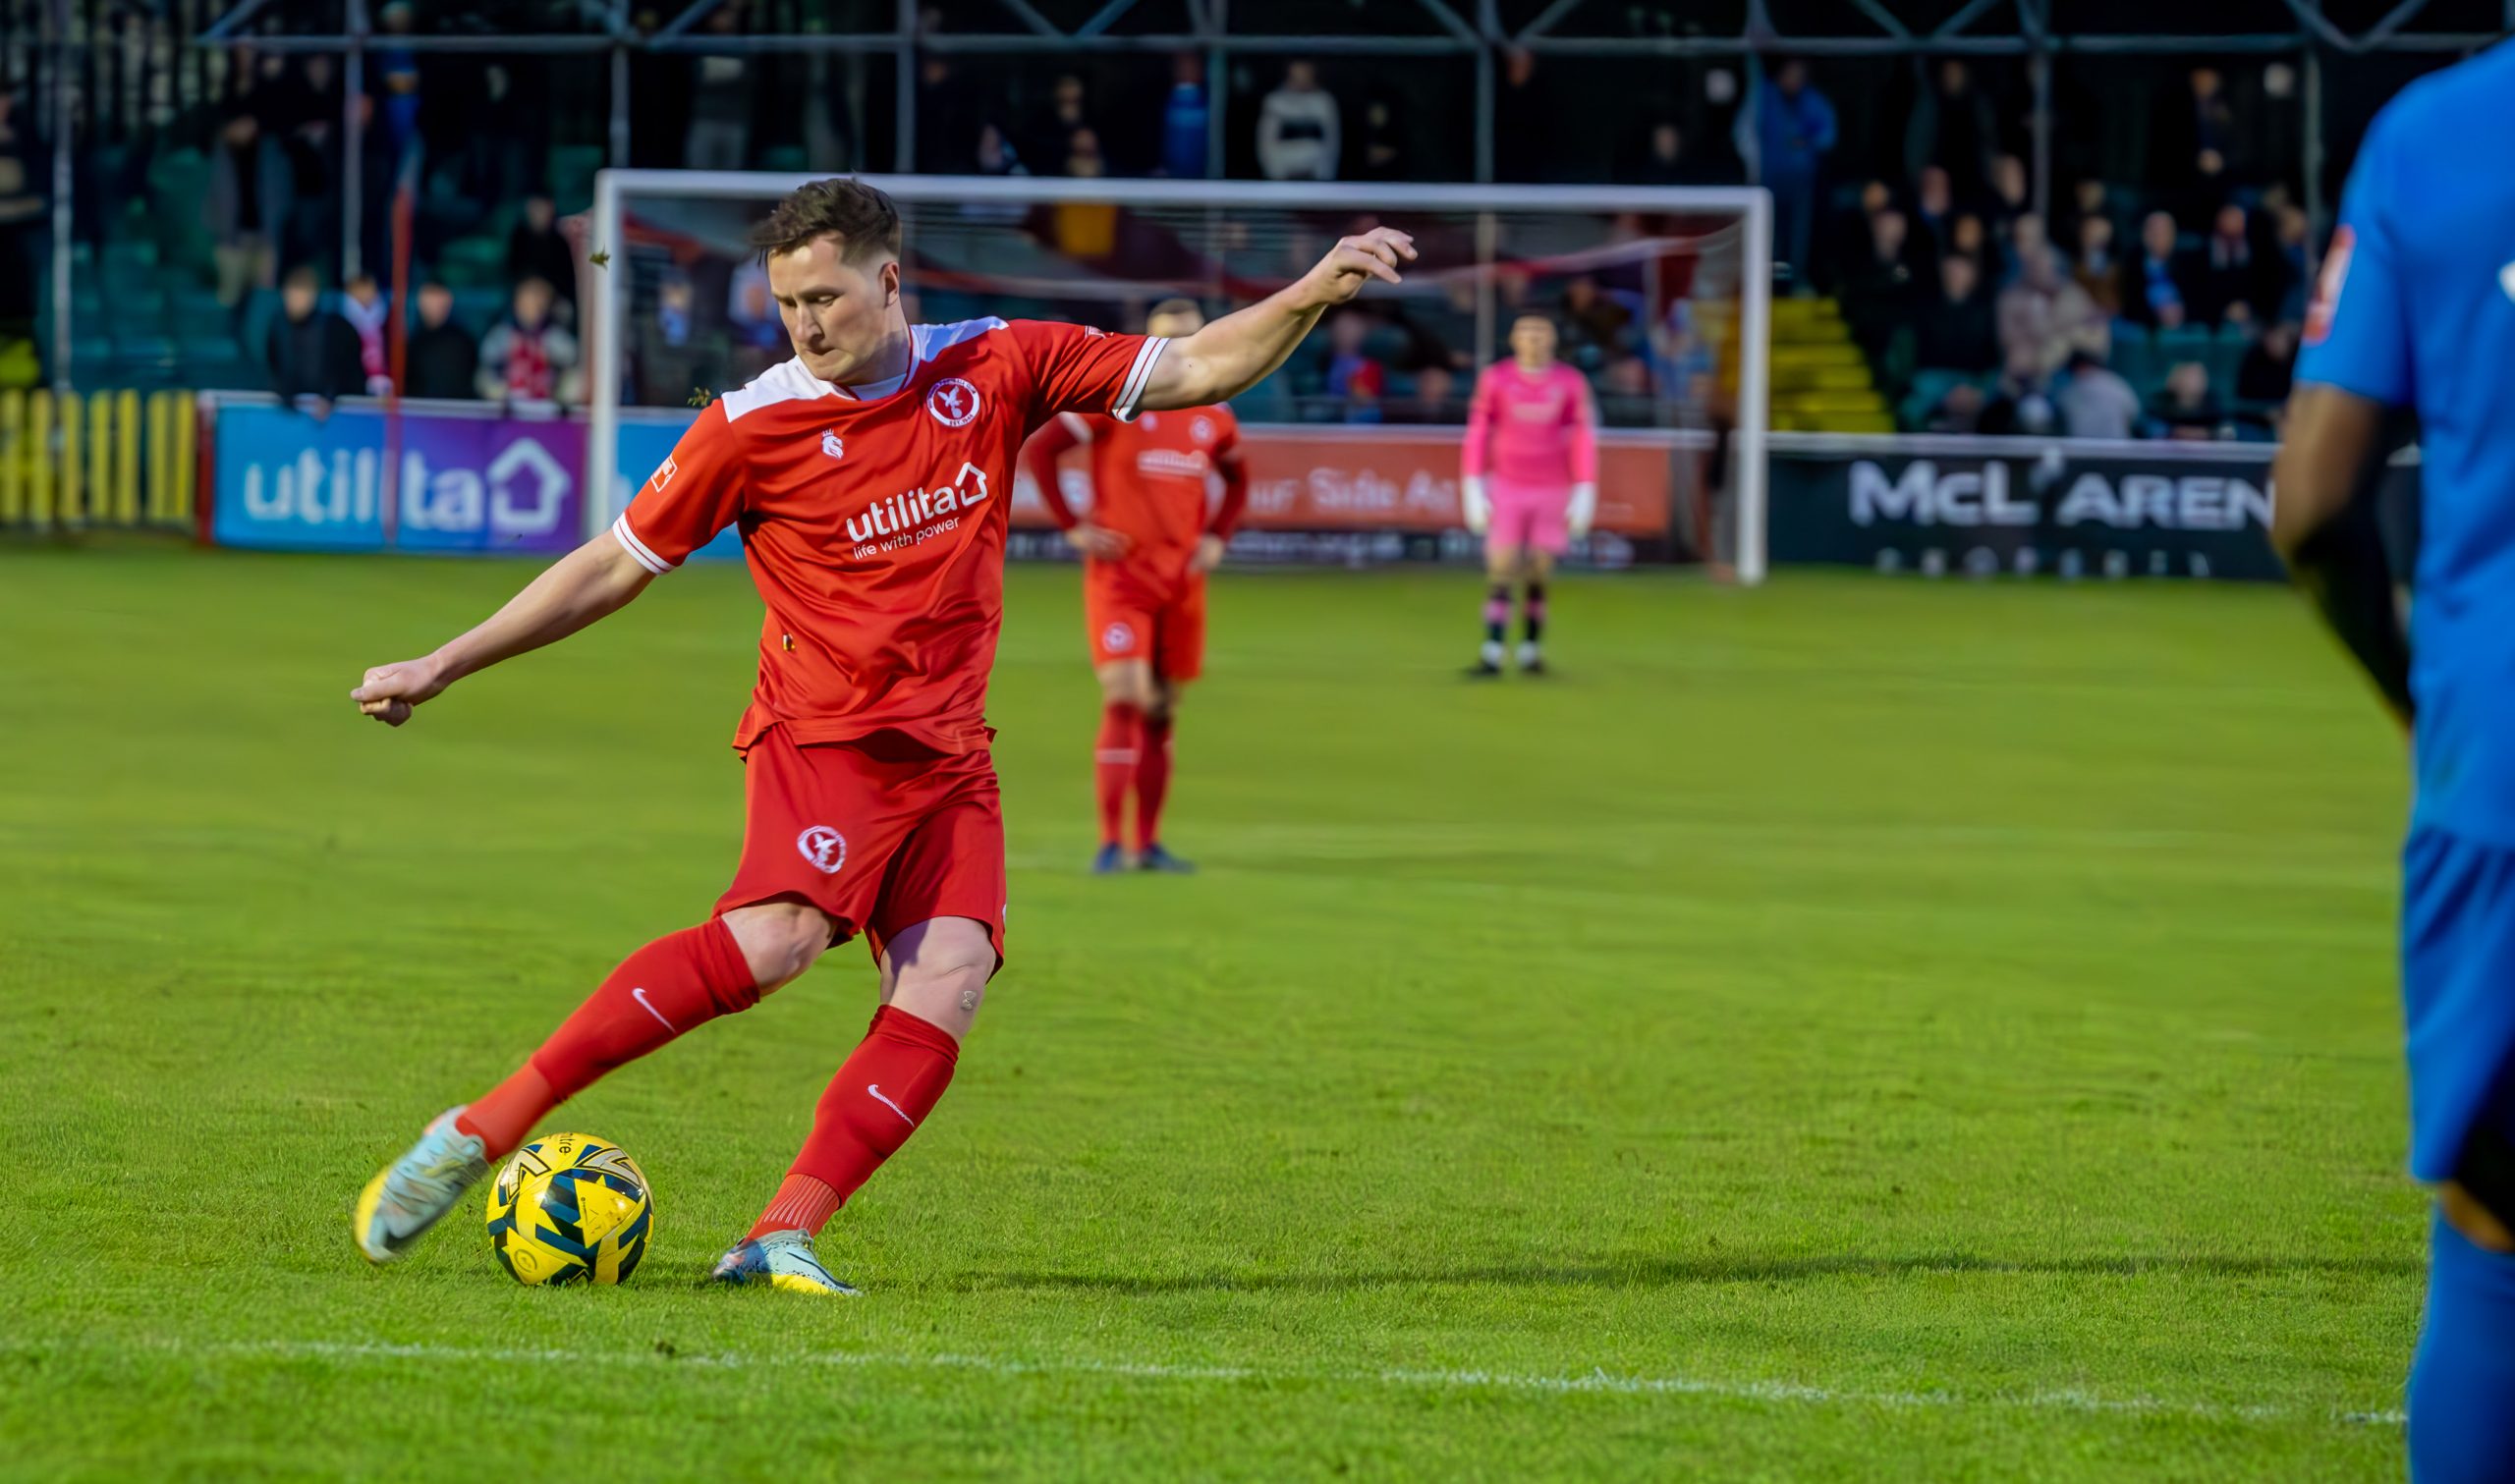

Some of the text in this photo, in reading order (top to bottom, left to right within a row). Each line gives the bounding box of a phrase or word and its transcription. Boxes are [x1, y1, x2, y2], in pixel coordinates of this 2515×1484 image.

[846, 487, 958, 542] utilita
[853, 517, 960, 561] life with power
